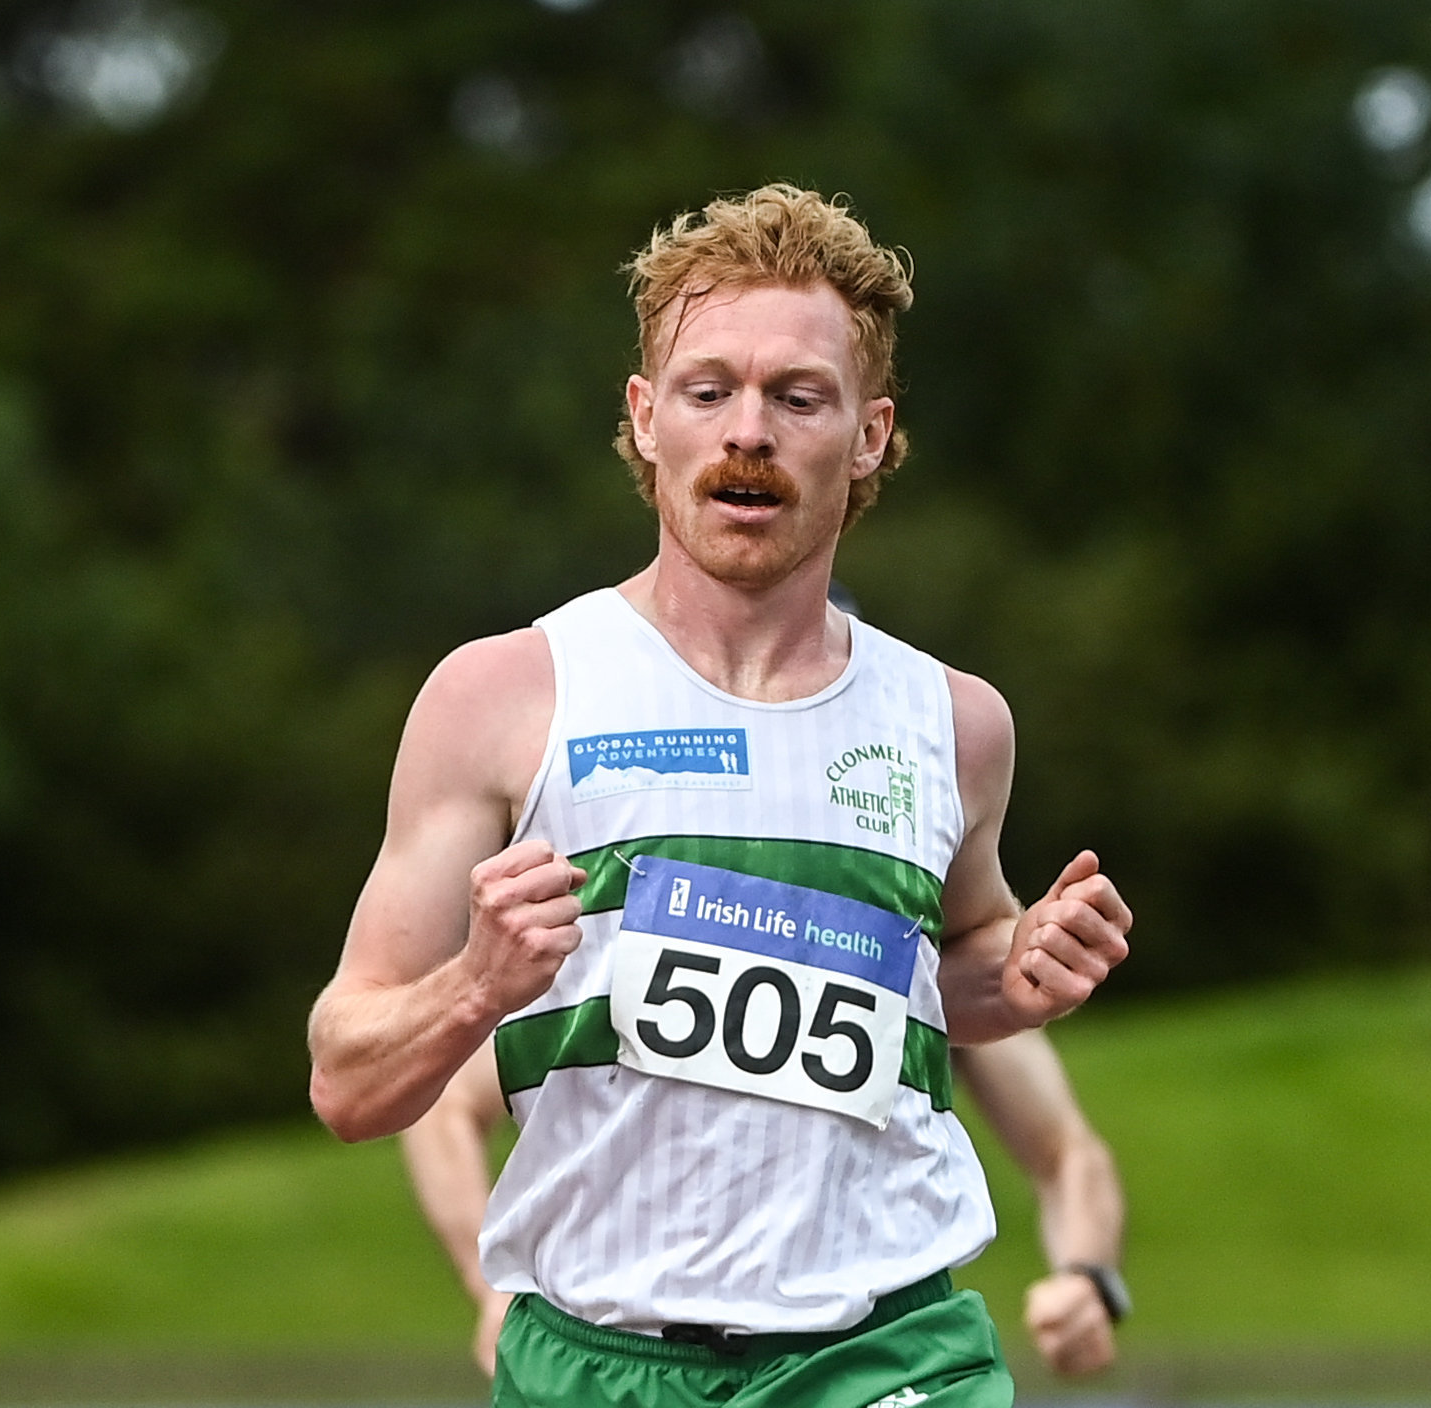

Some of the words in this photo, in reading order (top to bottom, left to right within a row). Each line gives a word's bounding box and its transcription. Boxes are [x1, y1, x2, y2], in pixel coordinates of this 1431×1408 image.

[573, 737, 646, 755] GLOBAL
[654, 734, 738, 746] RUNNING
[596, 747, 717, 763] ADVENTURES
[825, 743, 904, 782] CLONMEL
[829, 784, 890, 816] ATHLETIC
[855, 814, 890, 835] CLUB
[696, 895, 750, 929] Irish
[753, 907, 797, 939] Life
[804, 919, 883, 961] health
[635, 948, 877, 1093] 505
